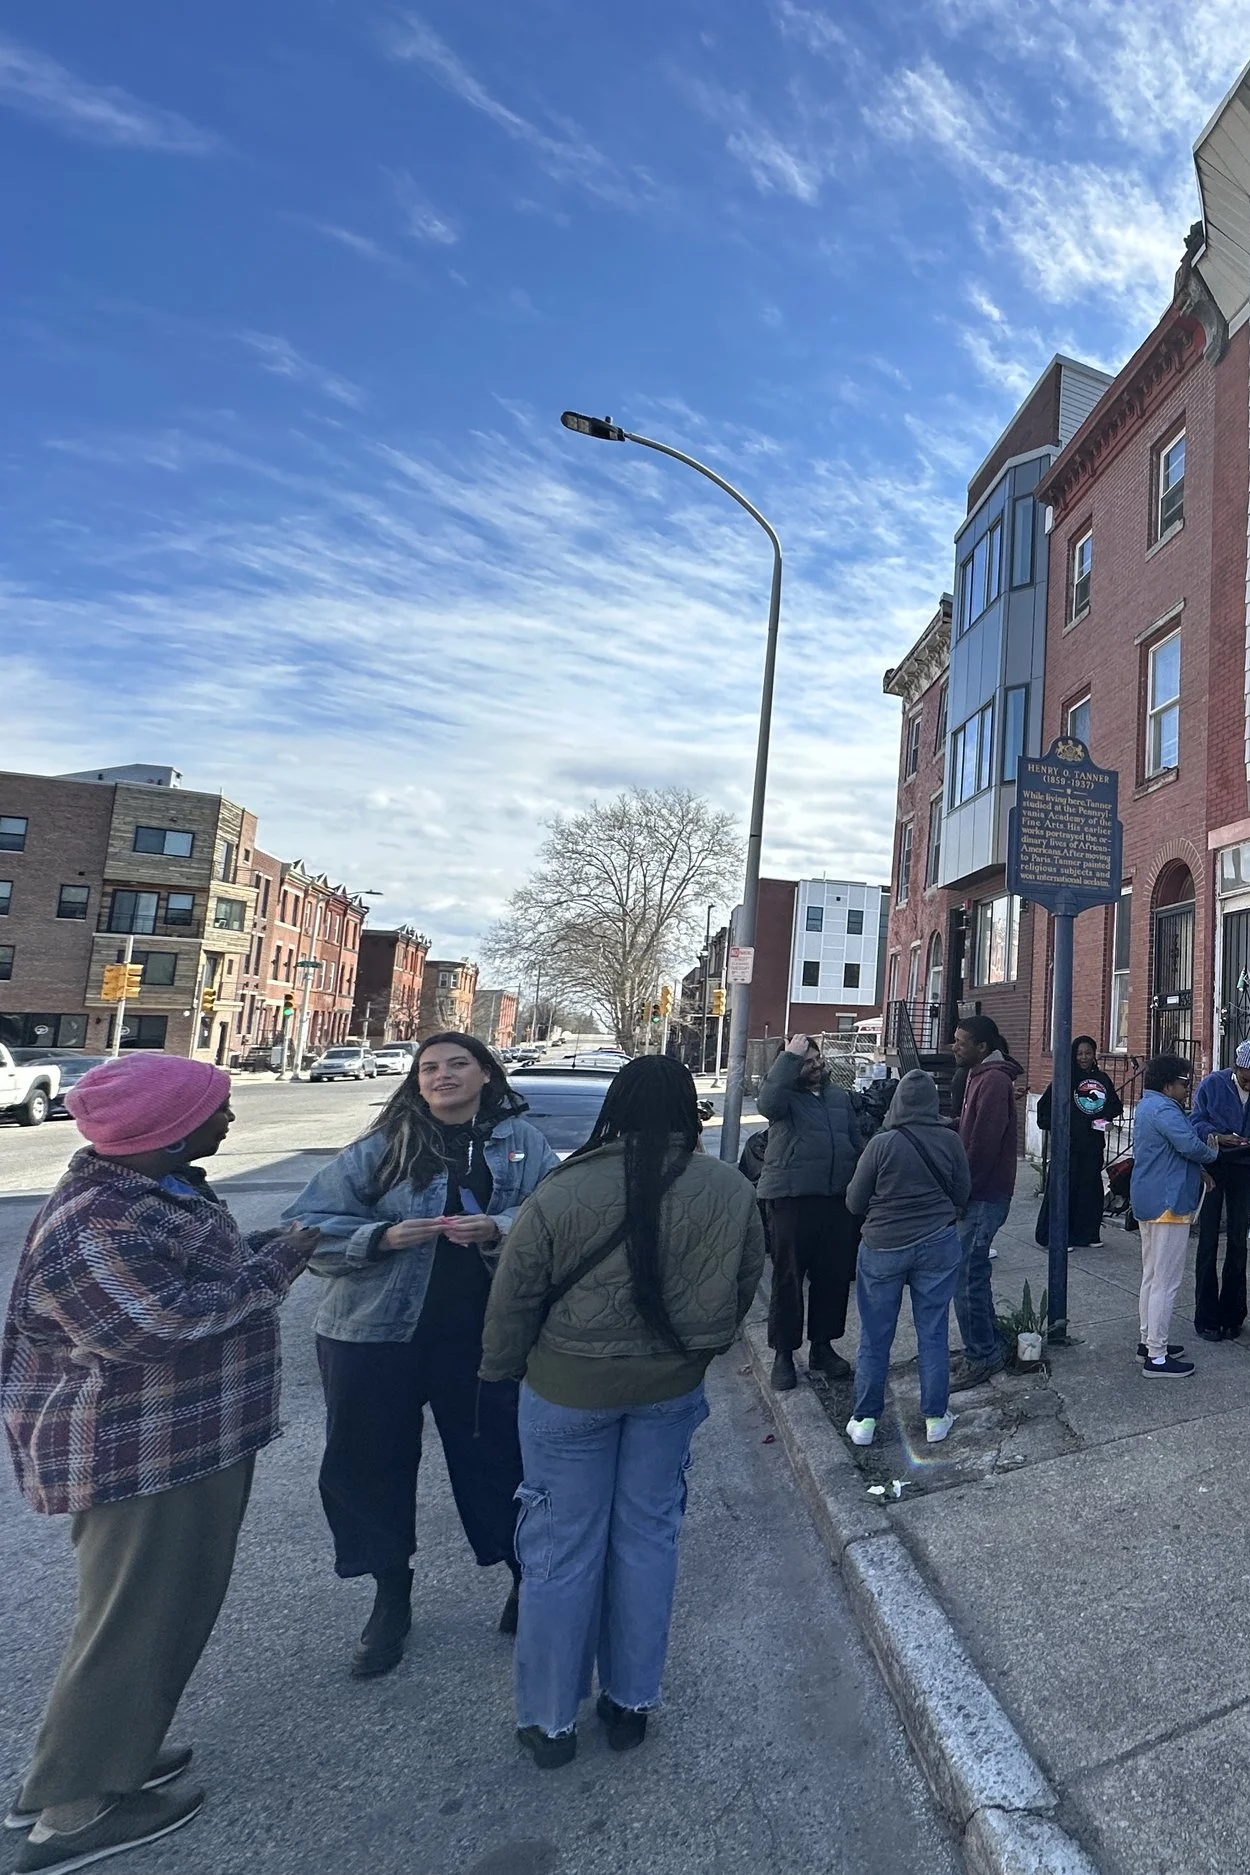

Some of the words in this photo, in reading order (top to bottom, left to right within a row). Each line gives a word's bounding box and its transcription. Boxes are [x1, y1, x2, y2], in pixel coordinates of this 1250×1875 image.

[1028, 764, 1059, 775] HENRY
[1074, 771, 1109, 783] TANNER
[1022, 800, 1051, 810] studied
[1064, 805, 1076, 813] the
[1023, 790, 1045, 800] While
[1046, 794, 1067, 804] living
[1087, 800, 1112, 810] Tanner
[1022, 810, 1045, 818] vania
[1048, 812, 1085, 825] Academy
[1100, 818, 1112, 826] the
[1022, 817, 1041, 826] Fine
[1067, 823, 1080, 831] His
[1084, 826, 1112, 835] earlier
[1022, 827, 1044, 835] works
[1046, 830, 1084, 841] portrayed
[1086, 834, 1097, 842] the
[1021, 836, 1048, 848] dinary
[1050, 839, 1066, 847] lives
[1069, 841, 1079, 849] of
[1079, 843, 1111, 852] African-
[1054, 856, 1081, 866] Tanner
[1083, 861, 1110, 870] painted
[1063, 849, 1084, 858] After
[1085, 854, 1111, 863] moving
[1020, 863, 1057, 873] religious
[1060, 867, 1093, 876] subjects
[1036, 874, 1081, 884] international
[1083, 878, 1110, 887] acclaim.
